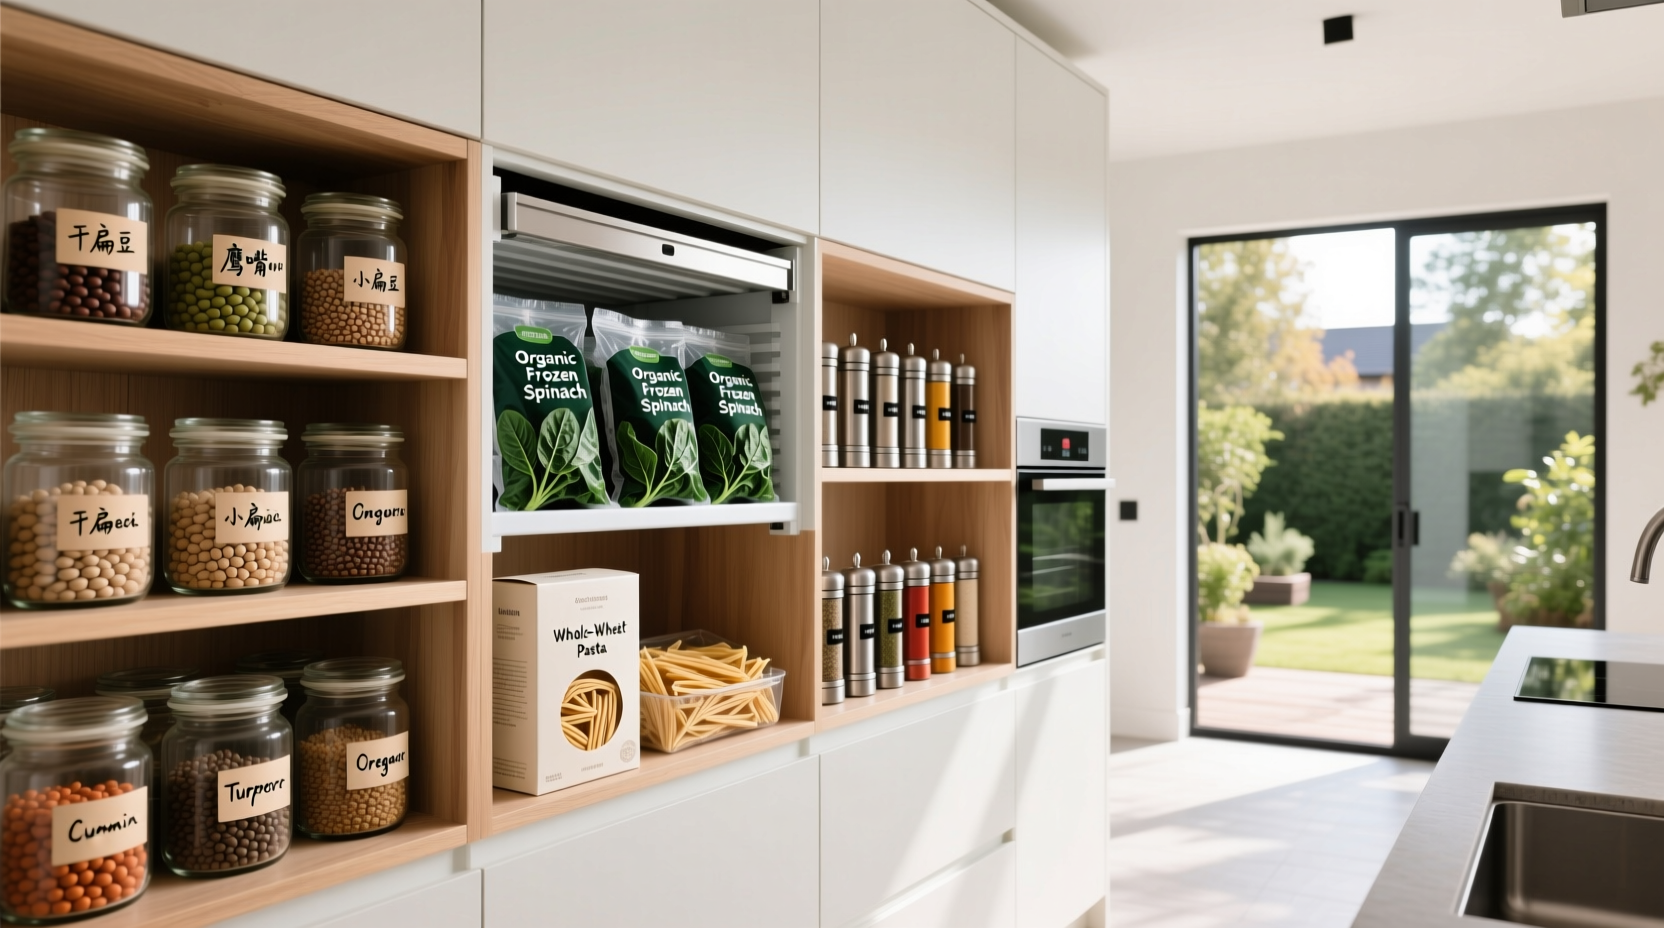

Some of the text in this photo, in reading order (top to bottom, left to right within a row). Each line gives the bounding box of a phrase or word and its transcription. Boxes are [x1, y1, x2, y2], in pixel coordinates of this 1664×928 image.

[67, 222, 135, 255] 干扁豆
[353, 268, 399, 292] 小扁豆
[515, 350, 577, 368] Organic
[526, 367, 578, 382] Frozen
[632, 367, 682, 384] Organic
[524, 382, 587, 403] Spinach
[641, 398, 690, 416] Spinach
[577, 642, 607, 658] Pasta
